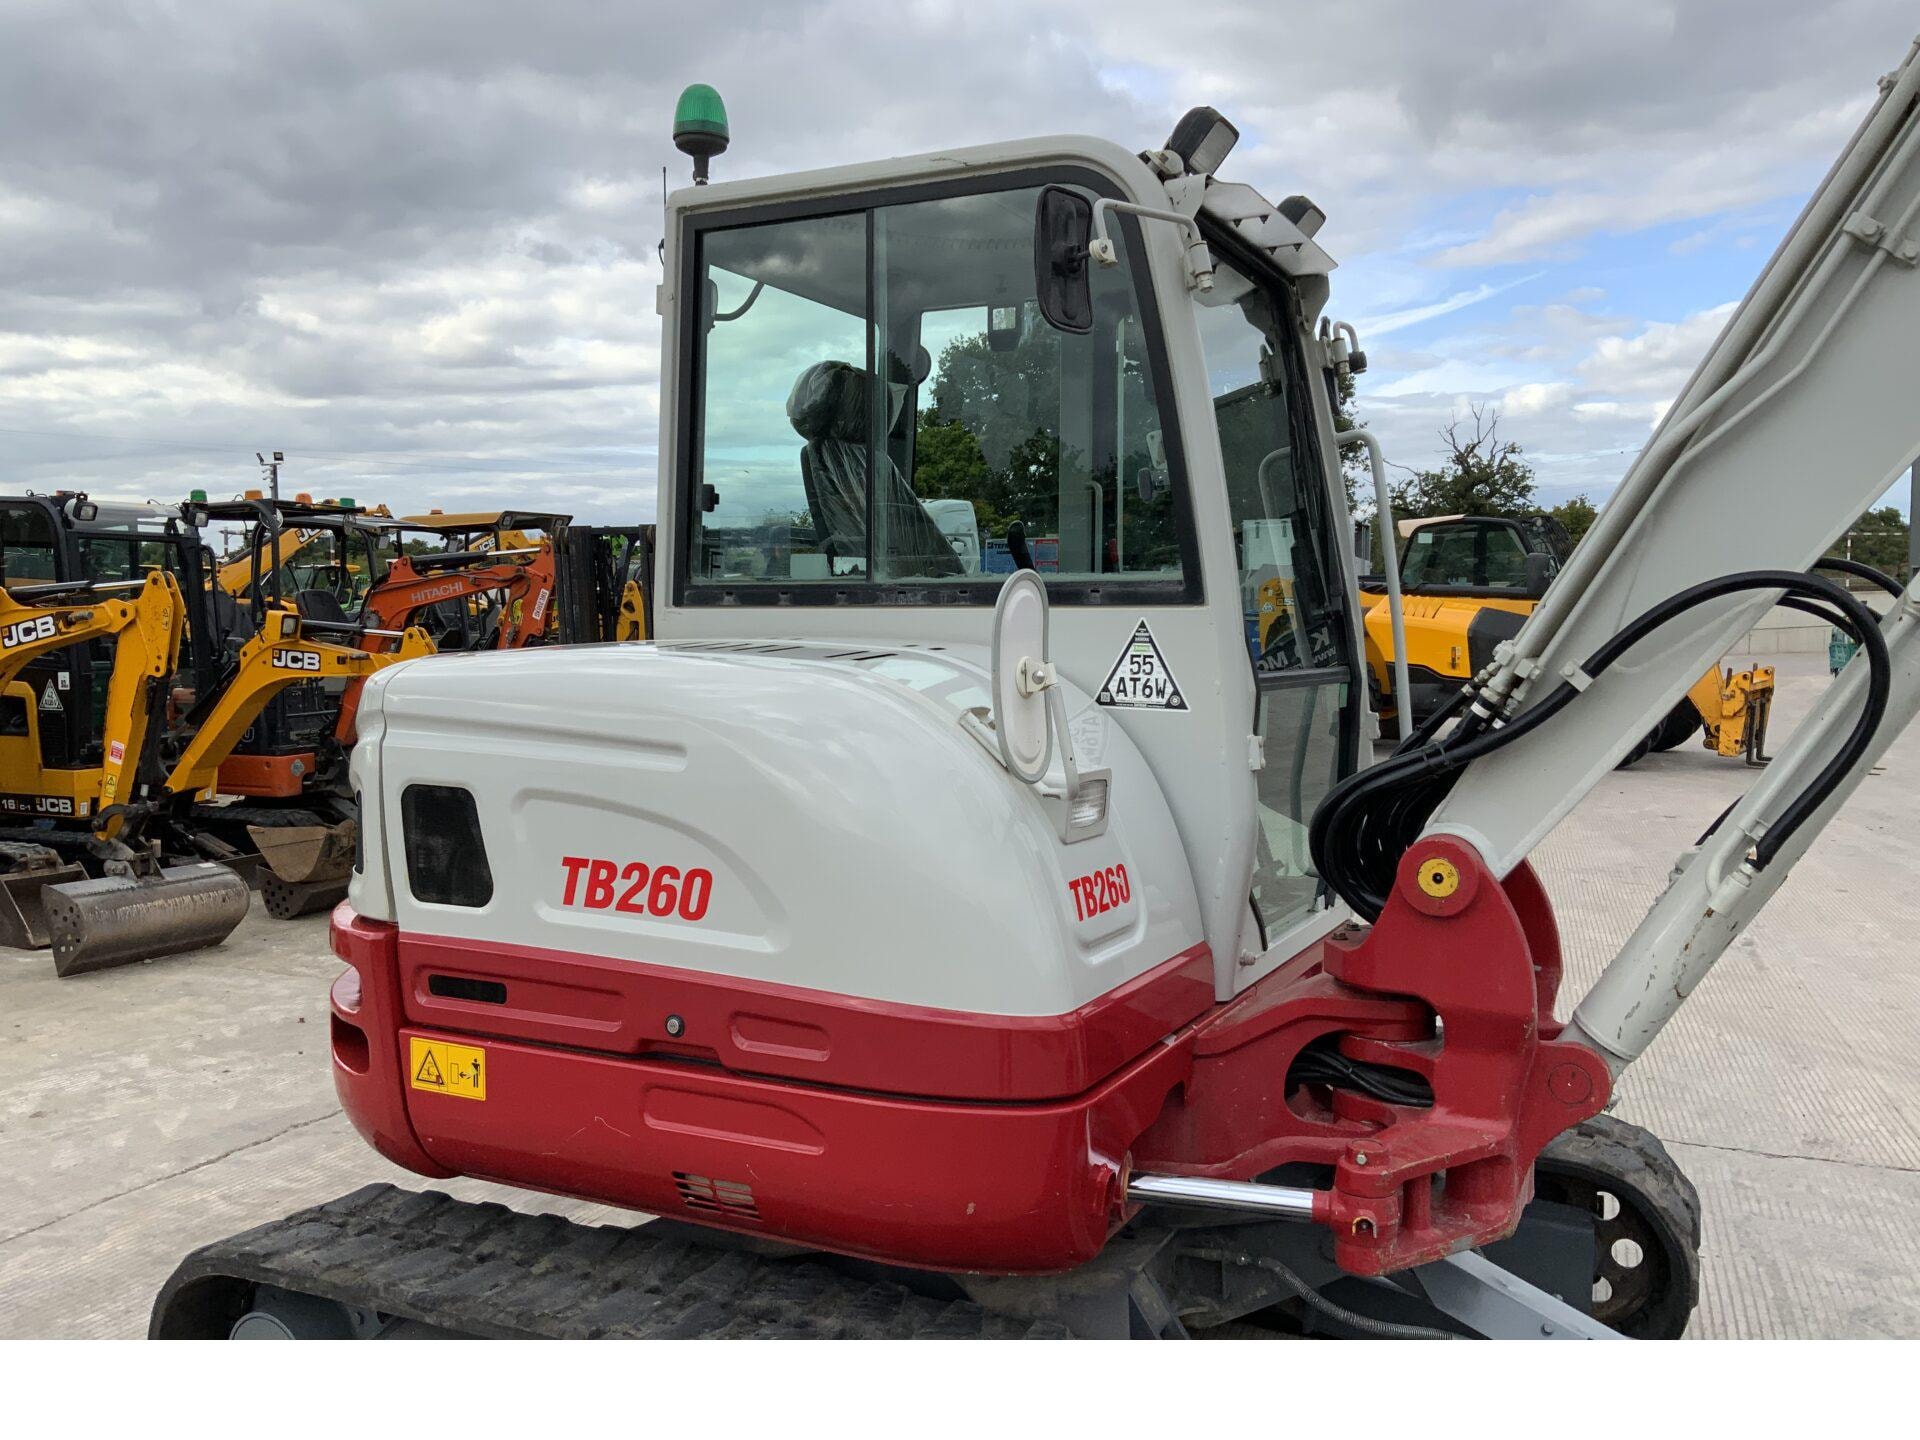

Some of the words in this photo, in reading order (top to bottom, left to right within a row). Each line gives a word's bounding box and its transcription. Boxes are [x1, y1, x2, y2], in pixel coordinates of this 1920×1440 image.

[411, 582, 463, 602] HITACHI
[3, 616, 56, 647] JCB
[273, 650, 320, 670] JCB
[1129, 654, 1154, 676] 55
[1116, 677, 1167, 699] AT6W
[37, 798, 72, 813] JCB
[562, 856, 713, 922] TB260
[1068, 863, 1131, 922] TB260
